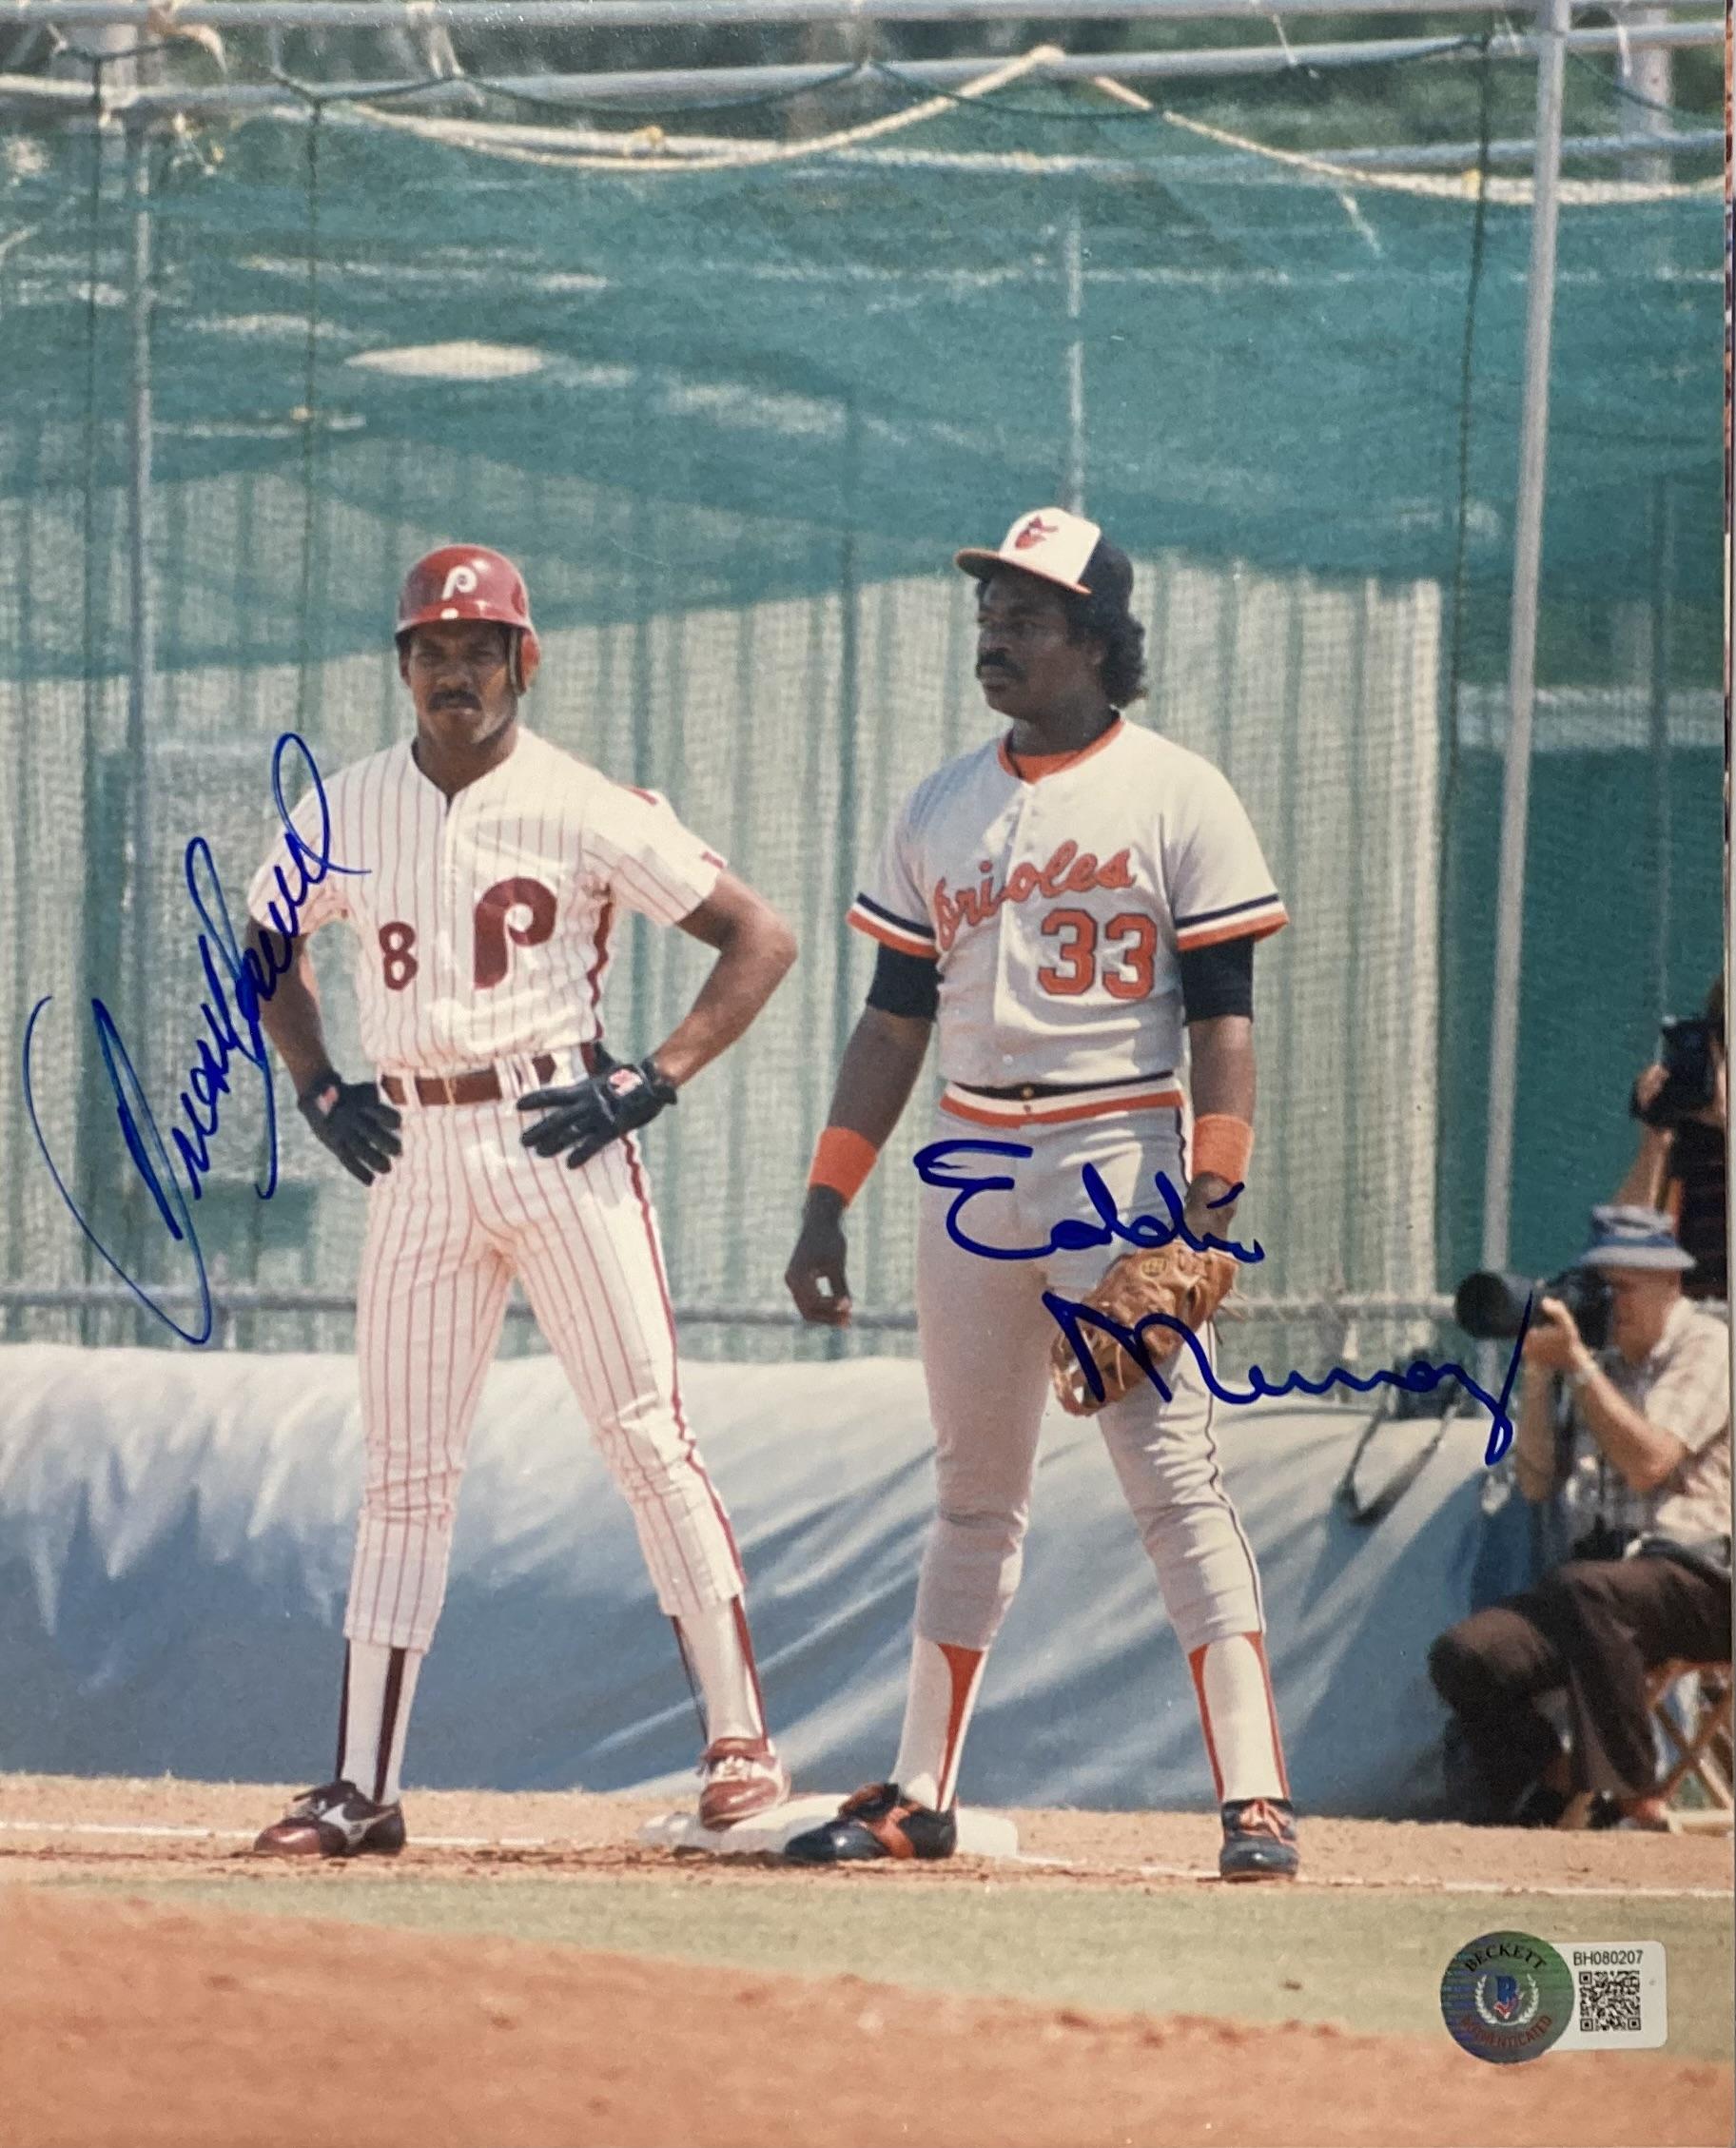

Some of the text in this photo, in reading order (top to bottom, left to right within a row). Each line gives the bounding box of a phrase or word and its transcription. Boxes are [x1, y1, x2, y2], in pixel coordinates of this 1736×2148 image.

[441, 565, 478, 601] P
[933, 839, 1137, 951] Orioles
[379, 920, 419, 991] 8
[474, 876, 558, 990] P
[1038, 908, 1158, 999] 33
[1465, 1943, 1548, 1972] BECKETT
[1573, 1949, 1645, 1966] BH080207
